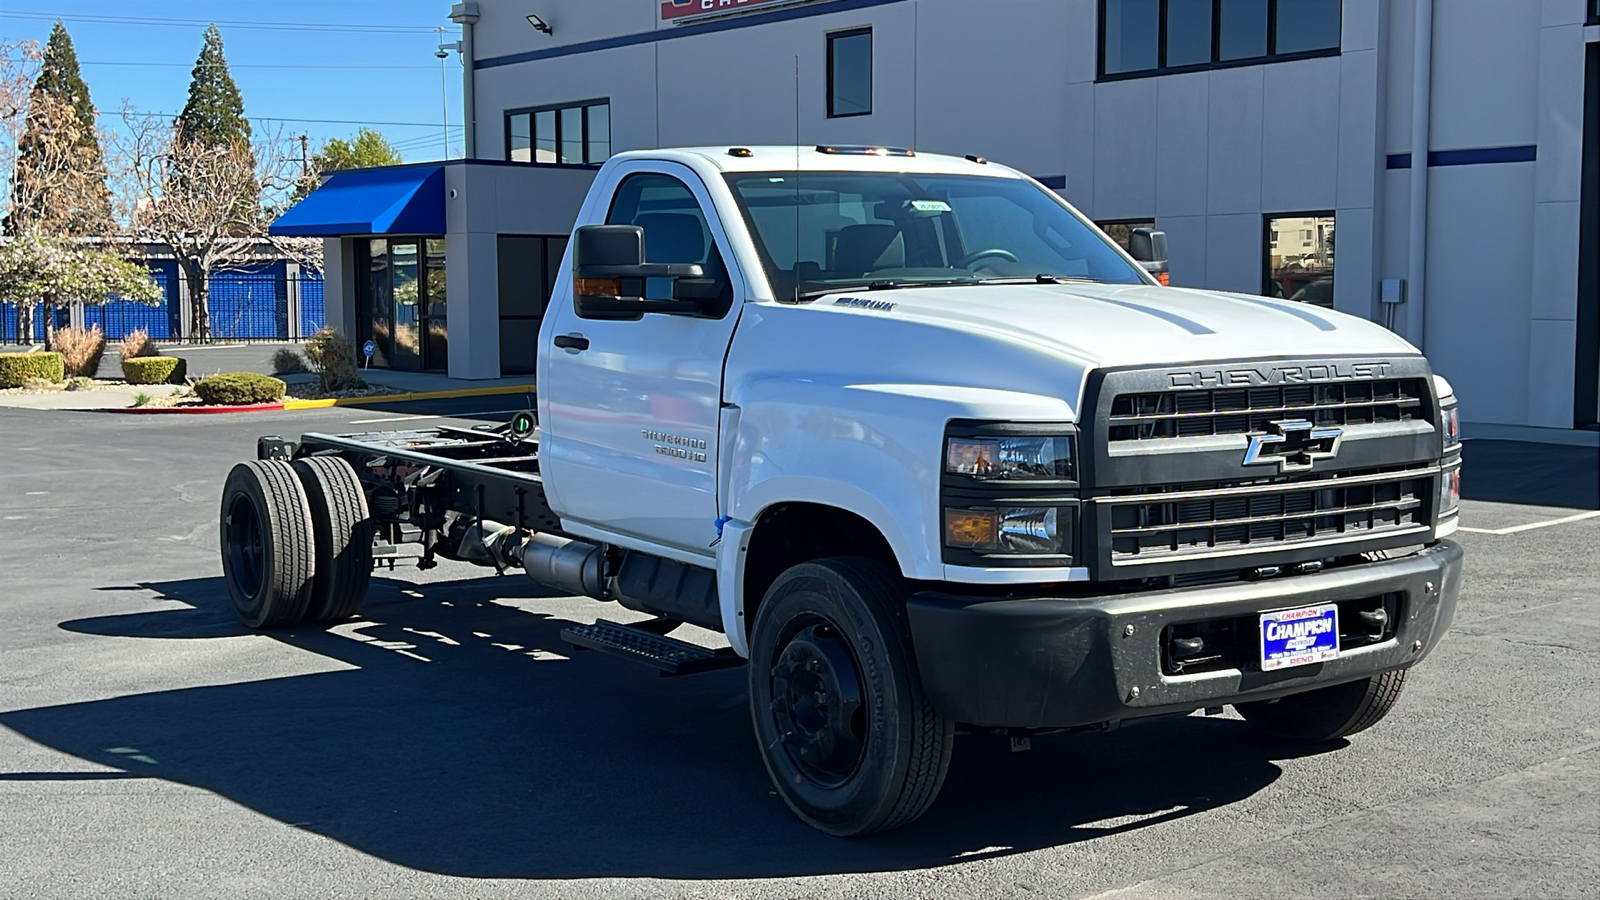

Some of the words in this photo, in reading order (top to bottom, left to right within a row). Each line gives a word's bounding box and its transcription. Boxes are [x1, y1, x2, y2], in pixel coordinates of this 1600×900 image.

[1167, 362, 1391, 390] CHEVROLET
[641, 429, 707, 450] SILVERADO
[1281, 609, 1318, 620] CHAMPION
[1266, 617, 1332, 641] CHAMPION
[1288, 638, 1315, 648] CHEVROLET
[1289, 655, 1314, 665] RENO
